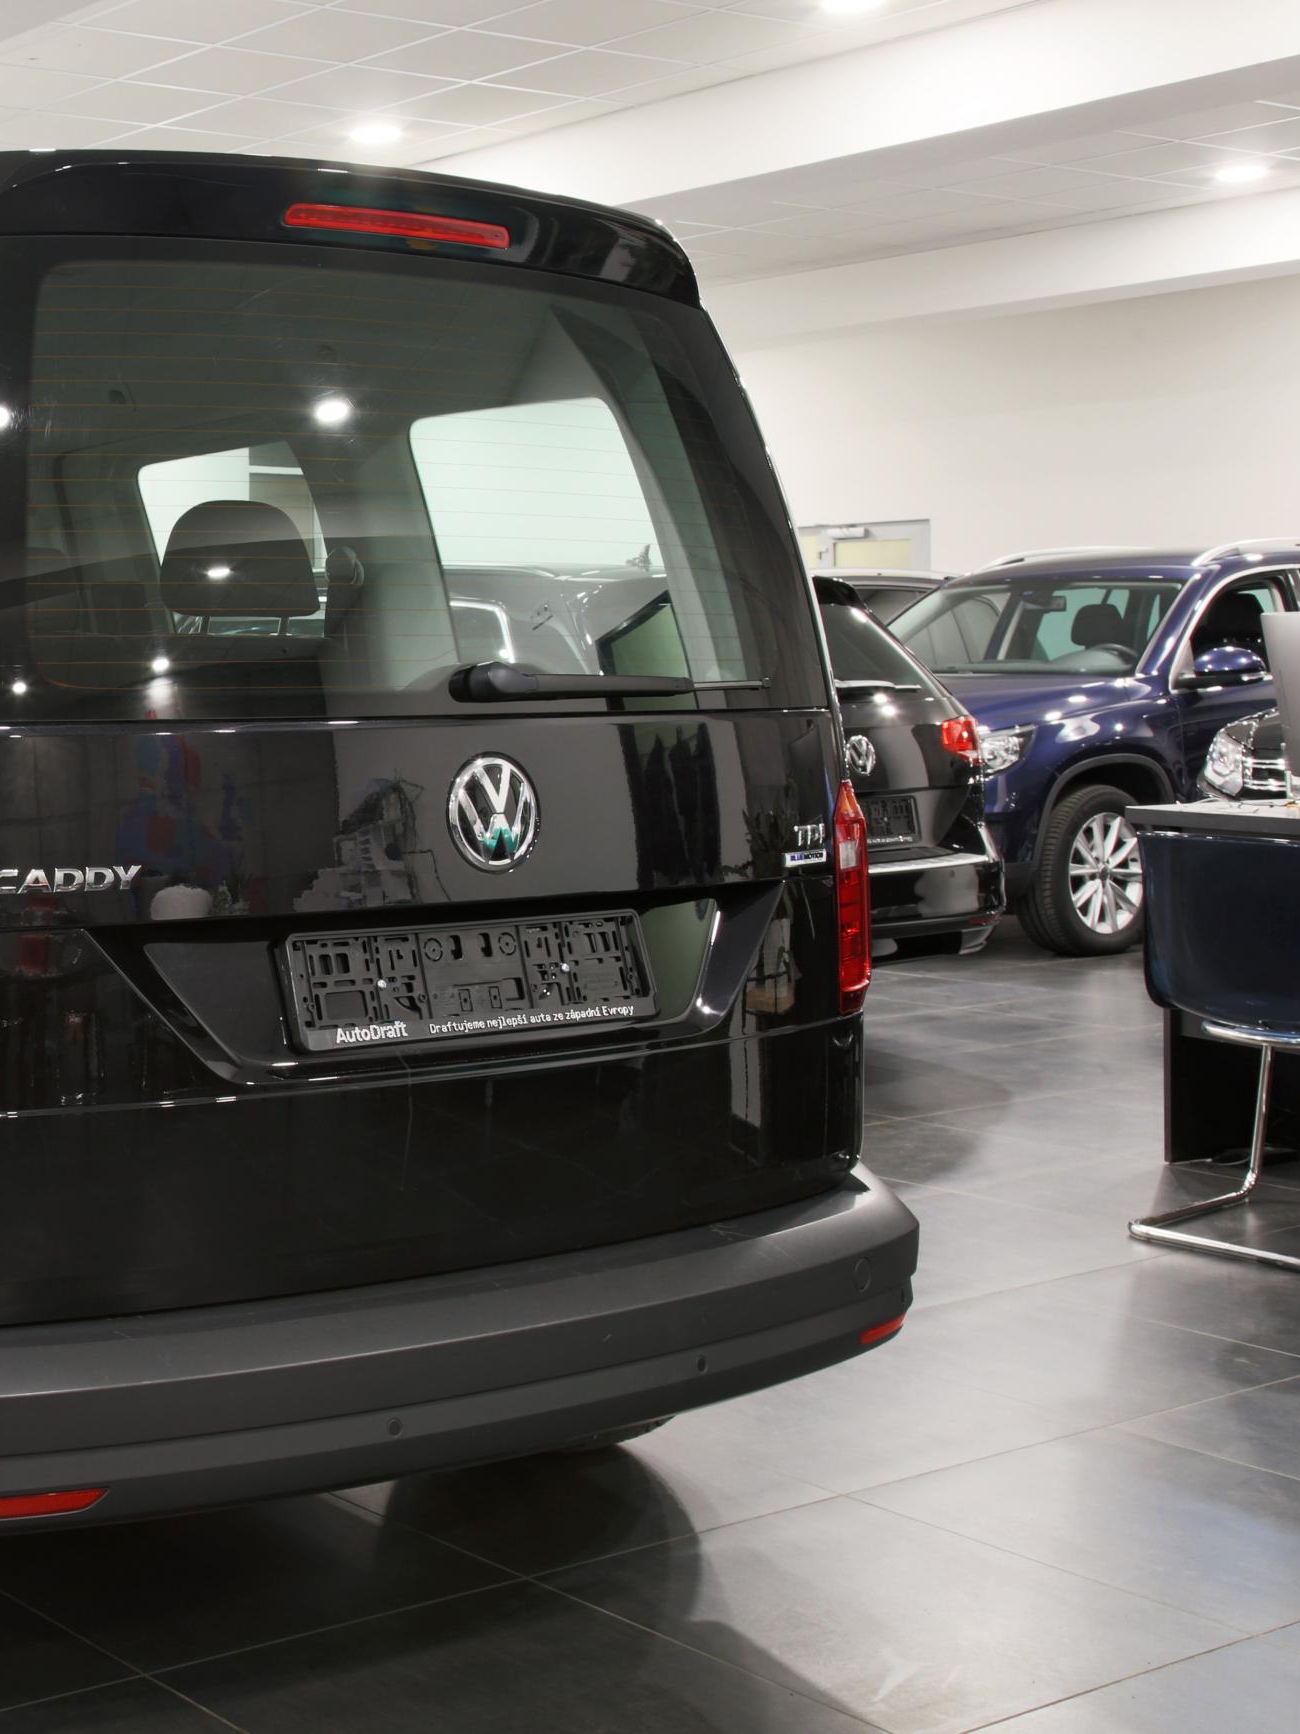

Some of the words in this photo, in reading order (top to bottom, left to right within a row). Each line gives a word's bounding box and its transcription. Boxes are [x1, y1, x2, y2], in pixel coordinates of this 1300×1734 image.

[794, 823, 825, 847] TDI
[429, 1020, 485, 1034] Draftujeme
[487, 1015, 527, 1029] nejlepší
[530, 1013, 551, 1023] auta
[553, 1011, 564, 1021] ze
[565, 1007, 600, 1021] západní
[602, 1005, 634, 1017] Evropy
[336, 1020, 408, 1044] AutoDraft
